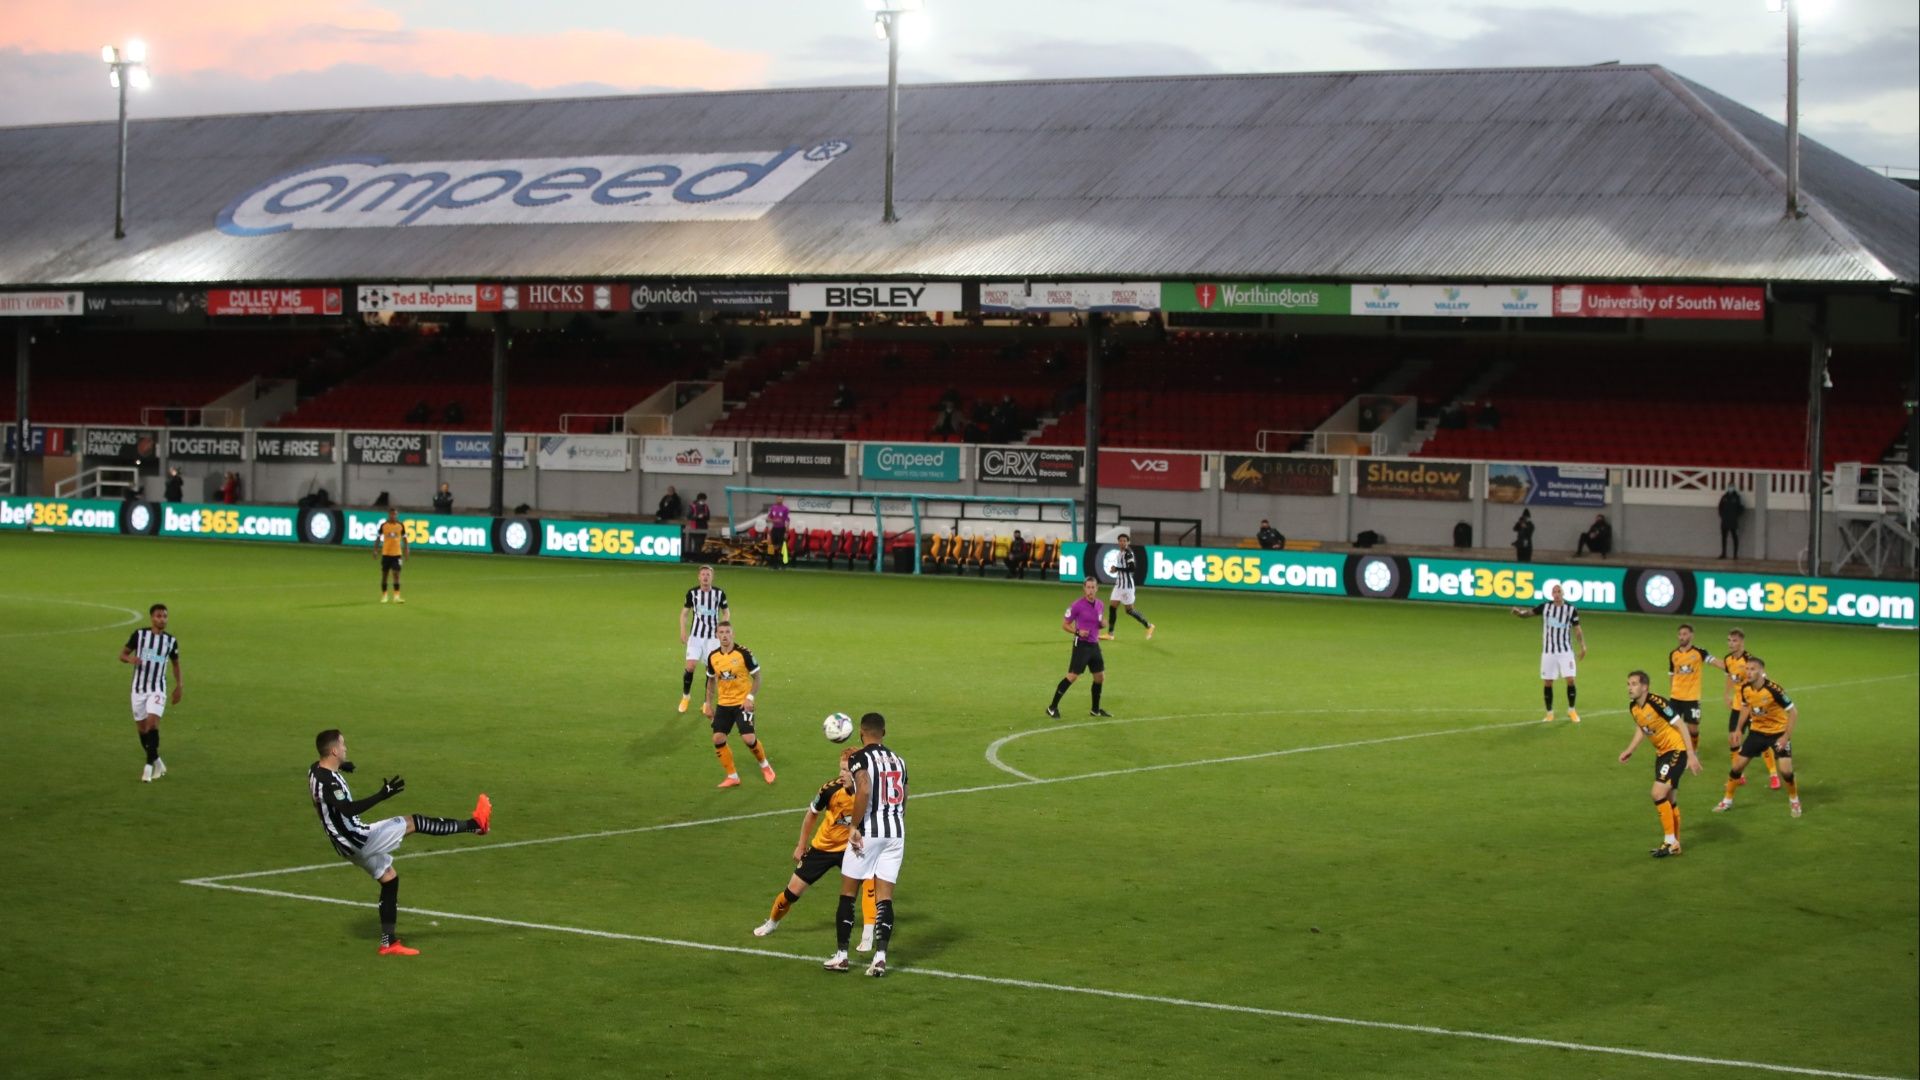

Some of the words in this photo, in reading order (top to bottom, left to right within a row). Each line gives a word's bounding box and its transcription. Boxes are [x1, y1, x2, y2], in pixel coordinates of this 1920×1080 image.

[216, 145, 803, 236] Compeed
[229, 289, 279, 306] COLLEY
[281, 289, 301, 306] MG
[392, 292, 416, 305] Ted
[419, 291, 473, 307] Hopkins
[529, 285, 585, 304] HICKS
[637, 284, 698, 304] Runtech
[825, 287, 926, 307] BISLEY
[1221, 284, 1319, 308] Worthington's
[1588, 294, 1656, 312] University
[1659, 294, 1673, 309] of
[1676, 295, 1716, 310] South
[1719, 296, 1761, 311] Wales
[88, 431, 137, 444] DRAGONS
[170, 438, 240, 456] TOGETHER
[353, 436, 421, 451] @DRAGONS
[455, 441, 491, 452] DIACK
[88, 443, 121, 456] FAMILY
[257, 440, 279, 455] WE
[282, 440, 319, 457] #RISE
[362, 449, 400, 463] RUGBY
[815, 456, 832, 465] CIDER
[877, 447, 944, 471] Compeed
[984, 450, 1038, 476] CRX
[1131, 459, 1168, 472] VX3
[1367, 463, 1462, 485] Shadow
[0, 501, 115, 528] bet365.com
[165, 508, 292, 536] bet365.com
[348, 516, 486, 546] be65.com
[1153, 551, 1337, 588] bet365.com
[1418, 564, 1616, 604] bet365.com
[1703, 578, 1915, 619] bet365.com
[742, 710, 754, 722] 17
[1660, 764, 1670, 776] 8
[880, 771, 904, 805] 13
